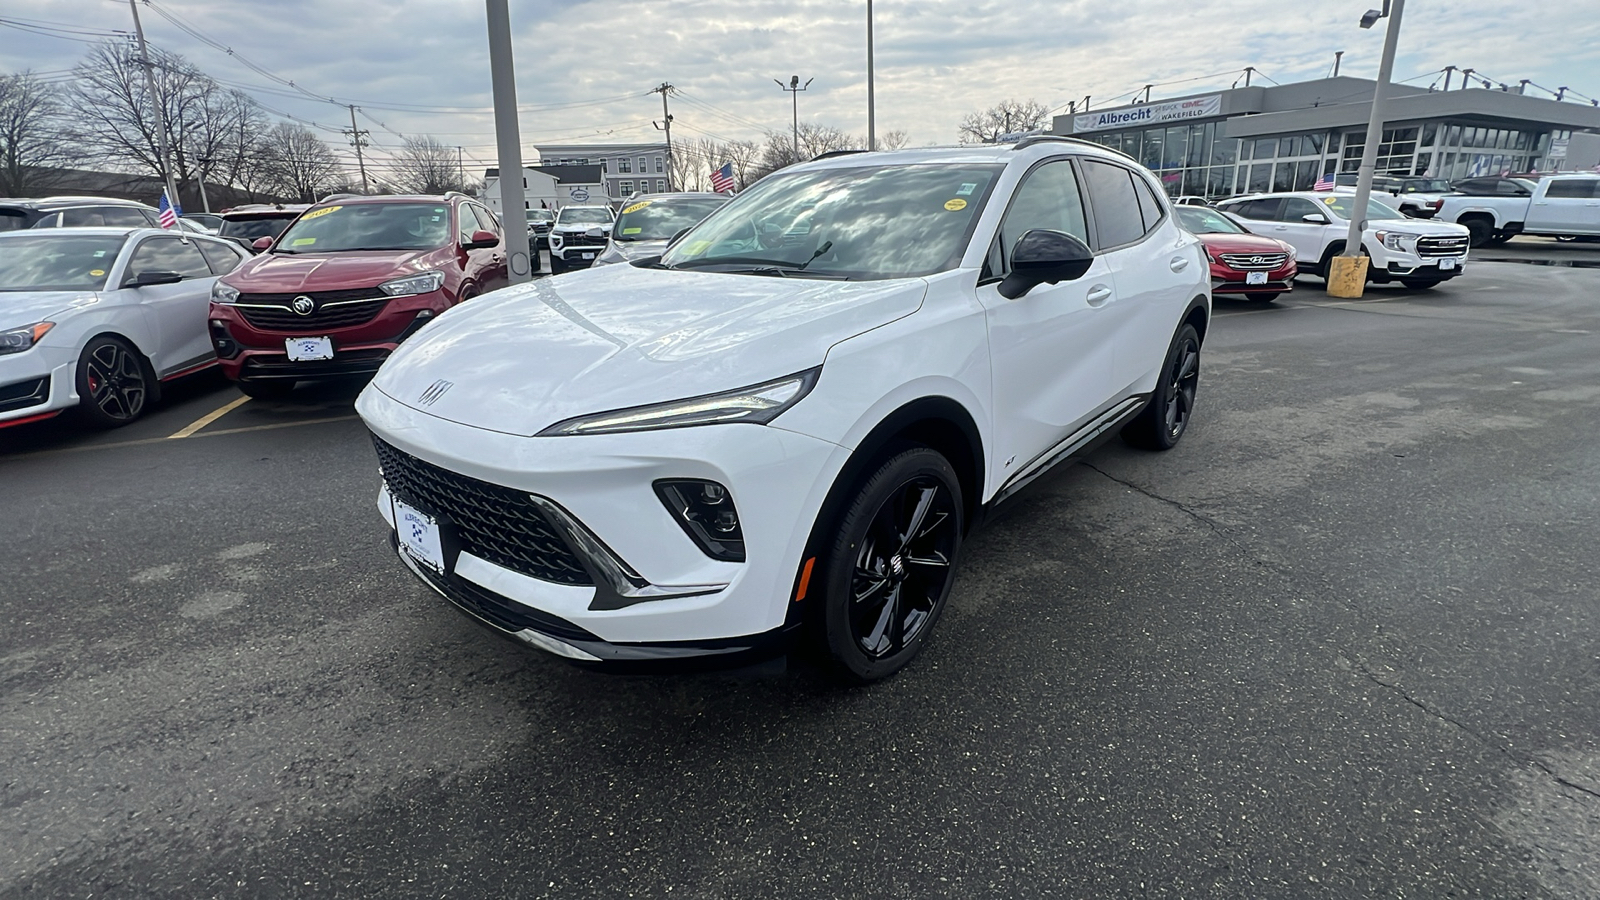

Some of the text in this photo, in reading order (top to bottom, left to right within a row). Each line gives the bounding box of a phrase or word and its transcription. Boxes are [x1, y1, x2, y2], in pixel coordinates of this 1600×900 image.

[1182, 100, 1204, 108] GMC
[1098, 108, 1151, 125] Albrecht
[1161, 110, 1203, 120] WAKEFIELD
[404, 513, 428, 533] ALBRECHT
